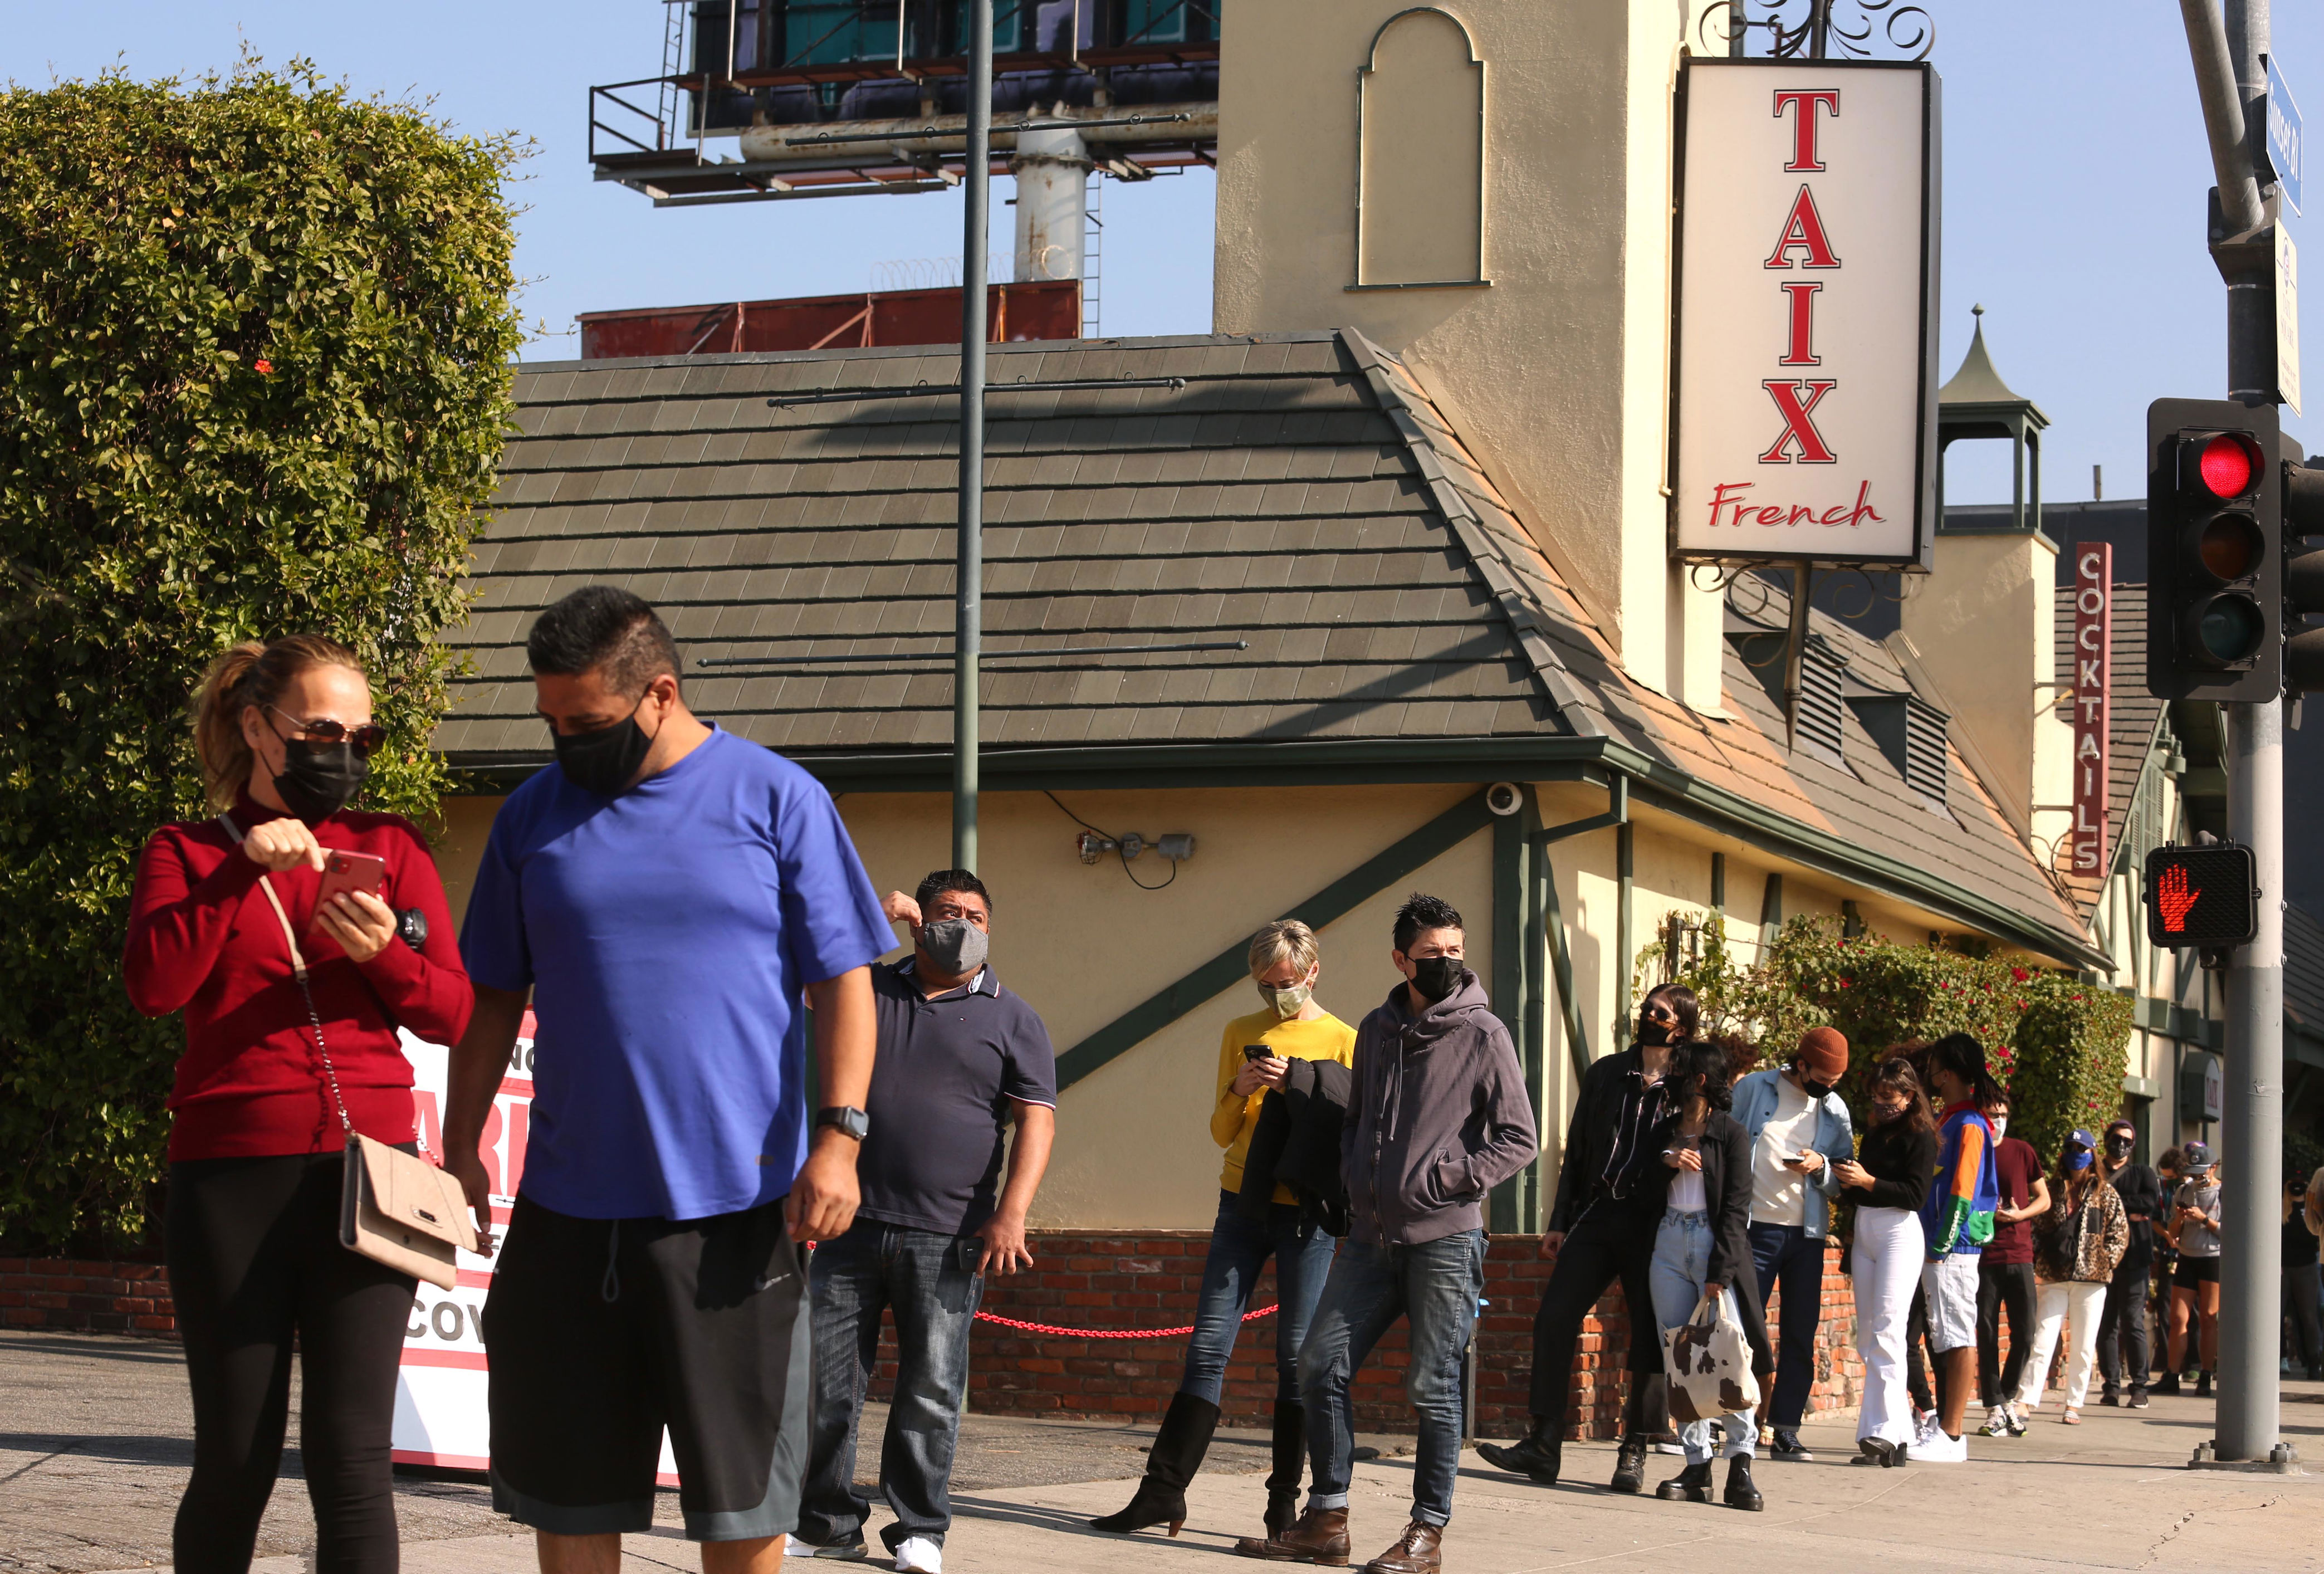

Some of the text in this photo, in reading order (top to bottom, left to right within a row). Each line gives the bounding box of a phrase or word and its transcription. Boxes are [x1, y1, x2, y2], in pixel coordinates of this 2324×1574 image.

[2269, 81, 2291, 165] Sunset
[1758, 88, 1841, 465] TAIX
[1708, 480, 1887, 529] French
[2075, 552, 2103, 869] COCKTAILS
